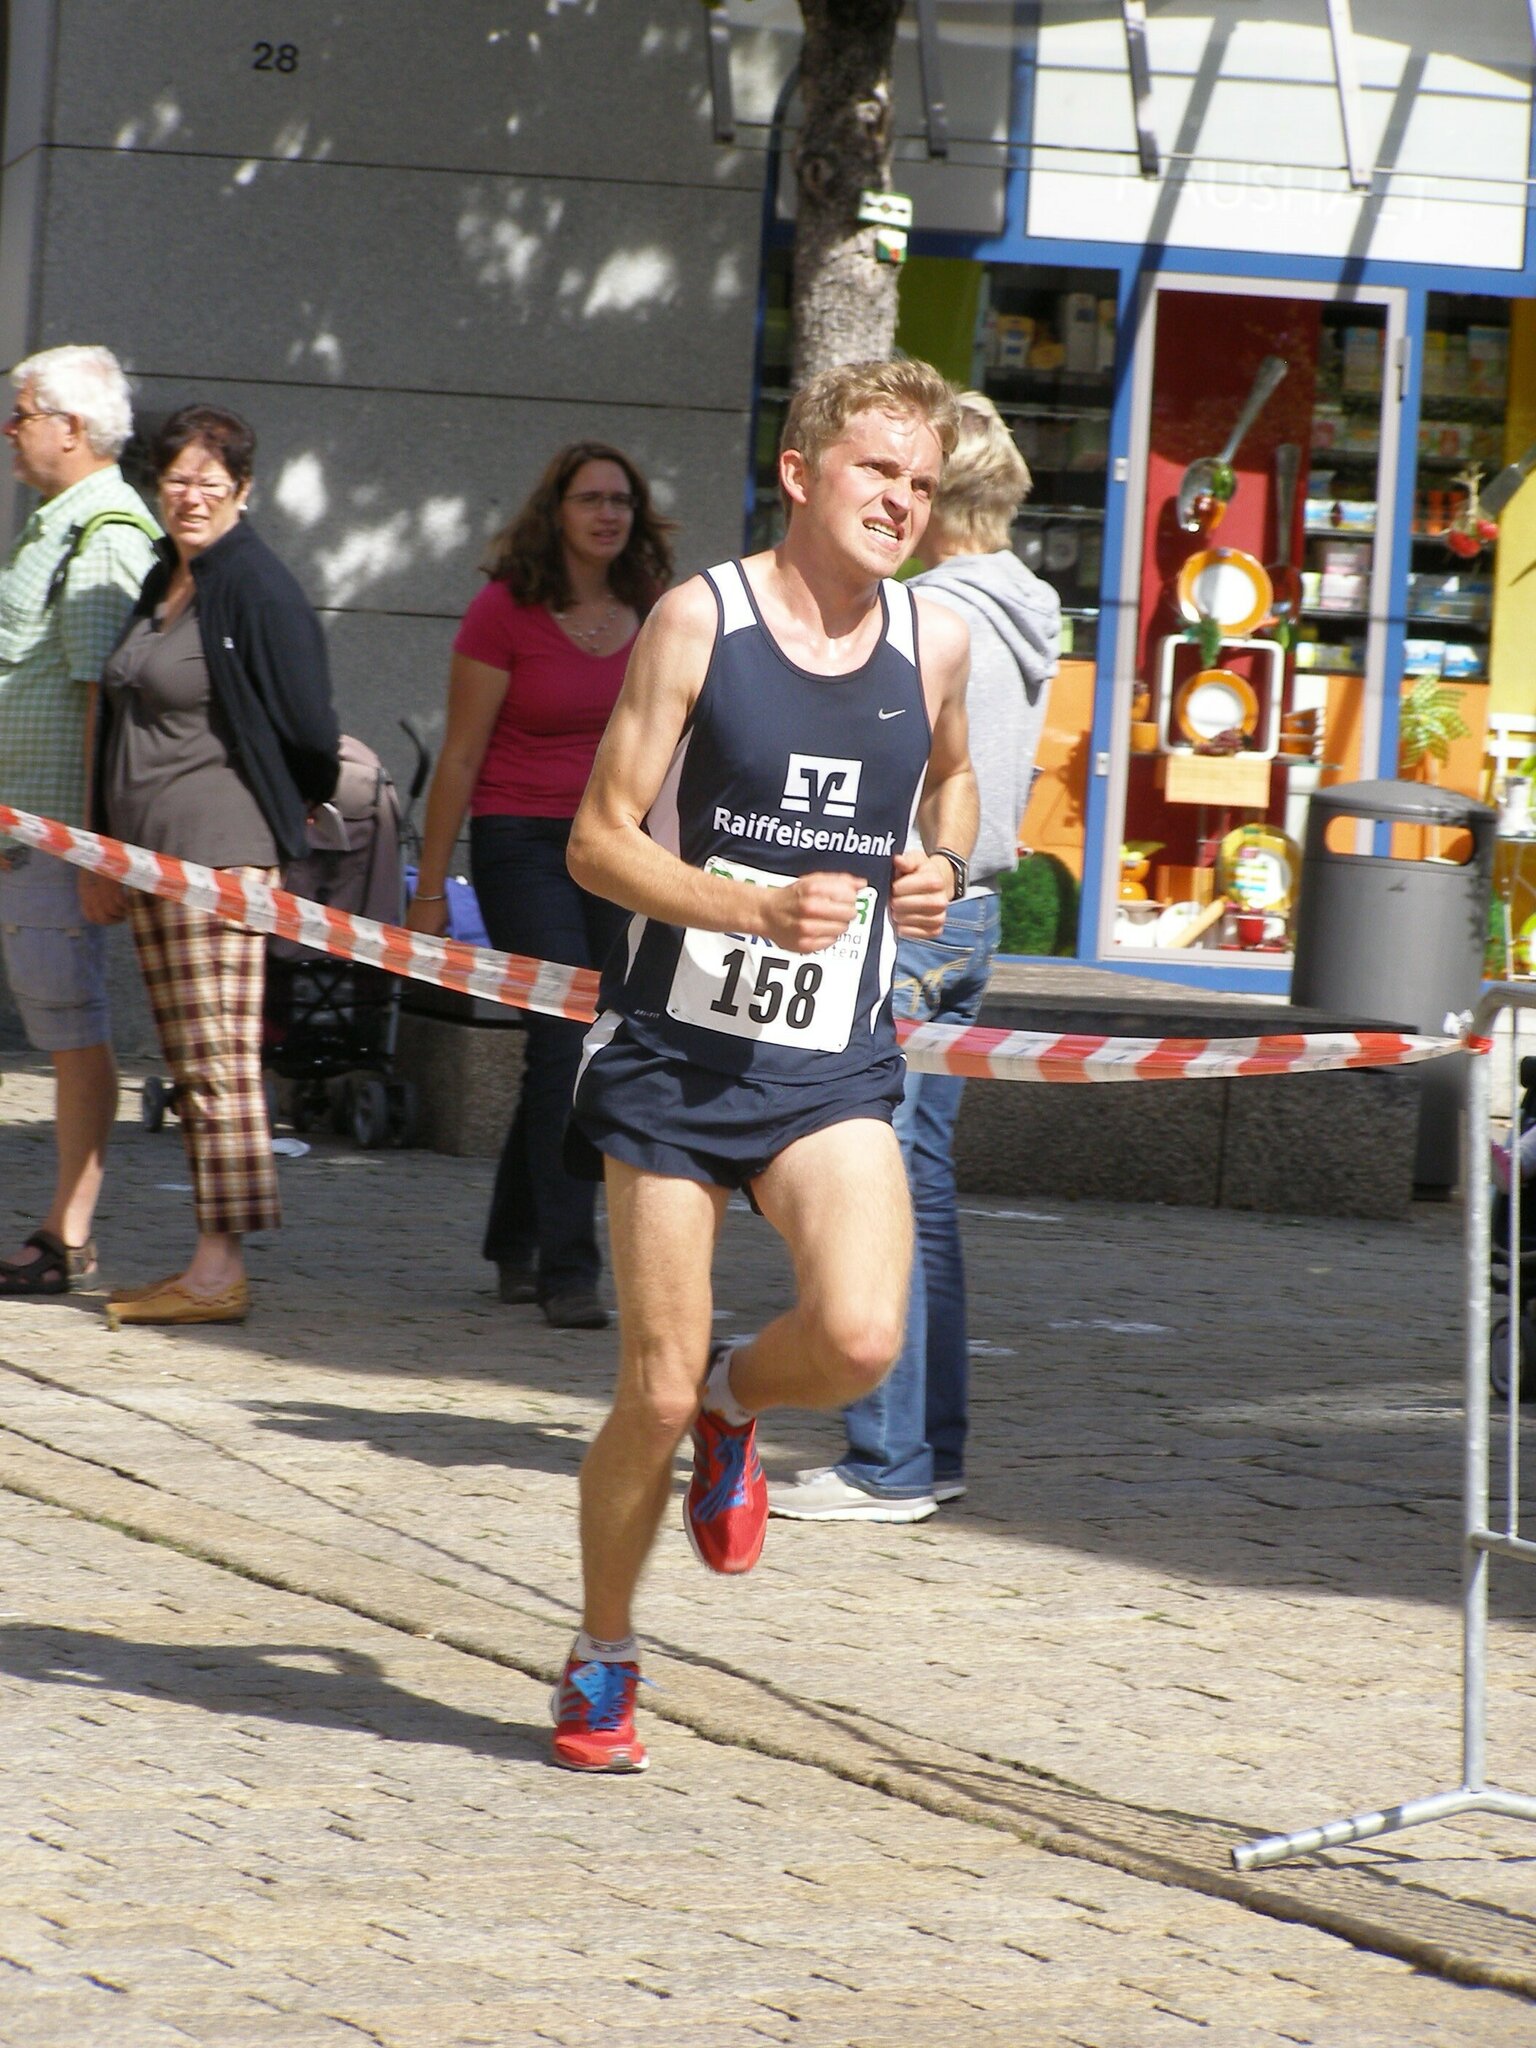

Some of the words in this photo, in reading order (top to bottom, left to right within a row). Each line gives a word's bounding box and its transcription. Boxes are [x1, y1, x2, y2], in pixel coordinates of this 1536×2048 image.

[253, 42, 298, 73] 28
[712, 806, 896, 857] Raiffeisenbank
[710, 948, 823, 1029] 158
